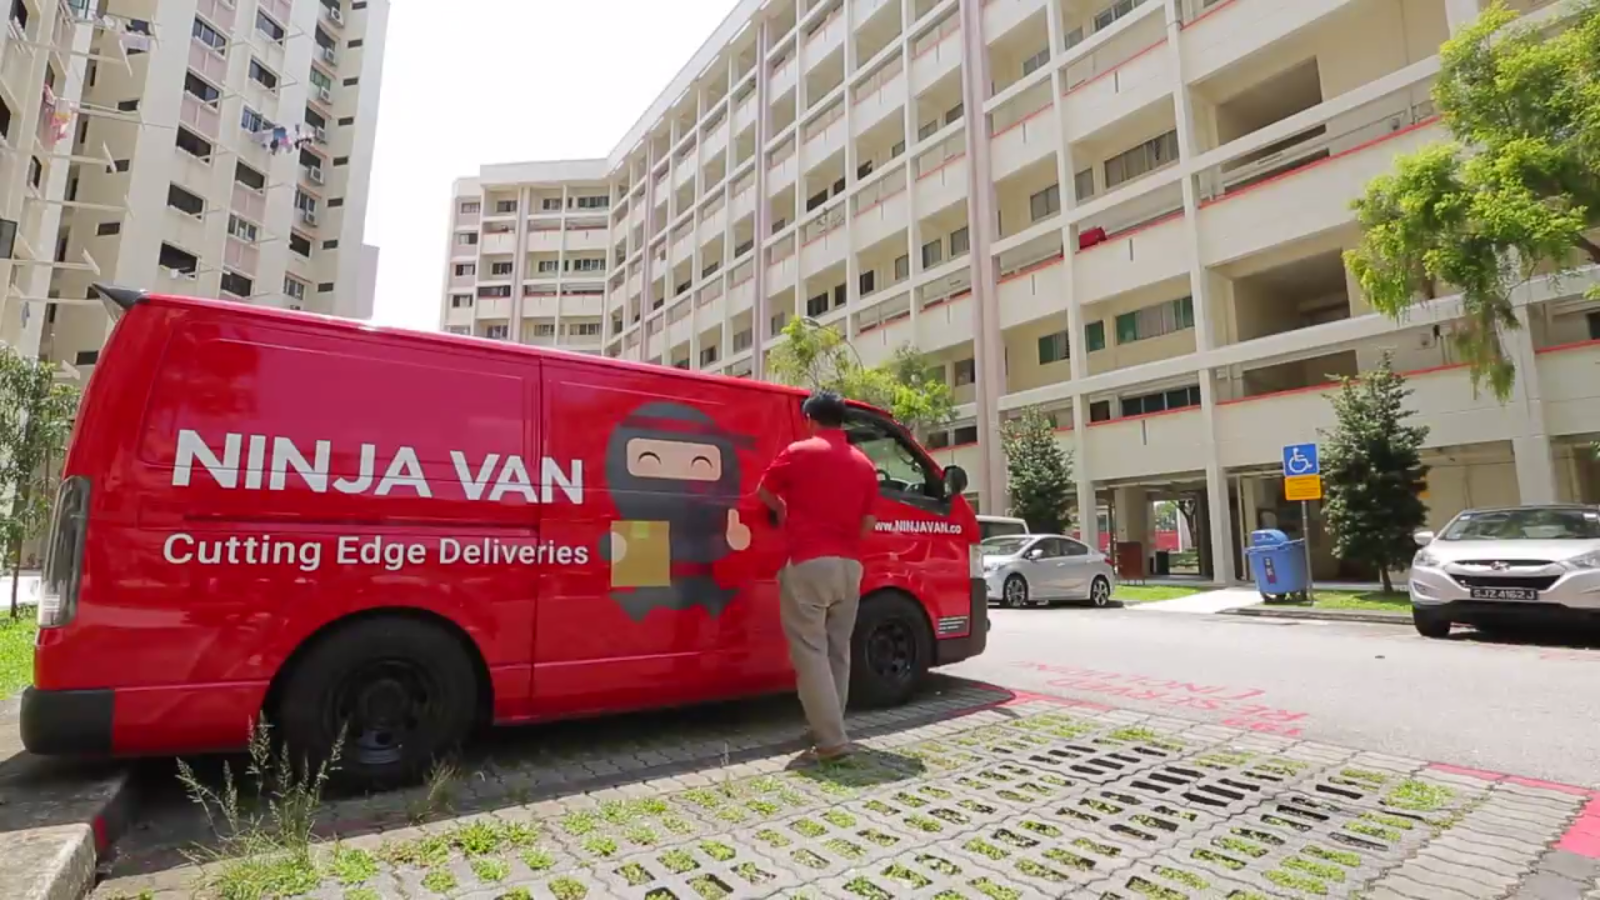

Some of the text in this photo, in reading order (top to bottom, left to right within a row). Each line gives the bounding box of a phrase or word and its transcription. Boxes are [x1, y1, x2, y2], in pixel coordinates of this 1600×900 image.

[172, 429, 583, 505] NINJA VAN
[874, 519, 962, 534] ww.NINJAVAN.co
[163, 532, 590, 571] Cutting Edge Deliveries
